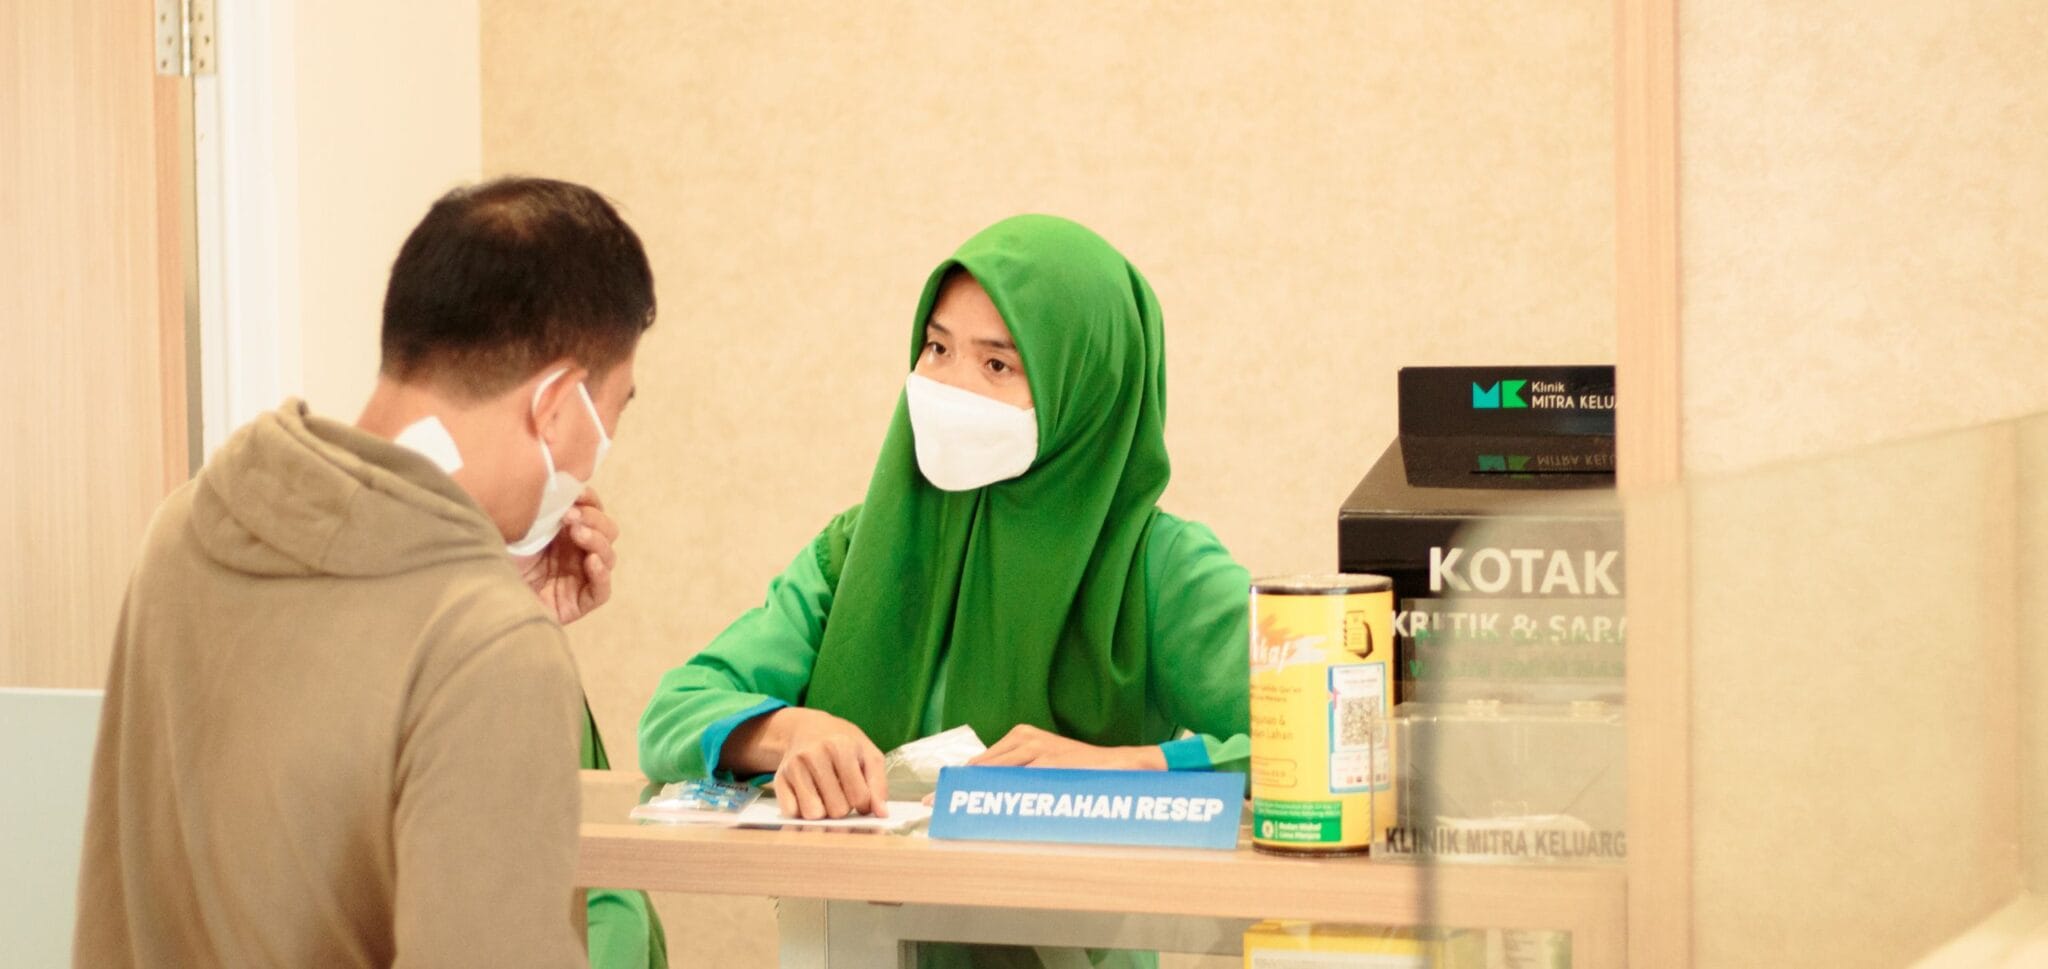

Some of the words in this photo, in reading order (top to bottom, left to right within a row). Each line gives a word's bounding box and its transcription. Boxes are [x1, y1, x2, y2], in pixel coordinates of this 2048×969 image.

[1532, 382, 1565, 392] Klinik
[1532, 396, 1575, 409] MITRA
[1580, 396, 1616, 409] KELU
[1429, 547, 1620, 595] KOTAK
[1392, 610, 1500, 639] KRITIK
[1511, 614, 1539, 640] &
[949, 790, 1132, 819] PENYERAHAN
[1135, 796, 1224, 822] RESEP
[1385, 828, 1461, 854] KLINIK
[1466, 829, 1529, 855] MITRA
[1535, 830, 1627, 857] KELUARG
